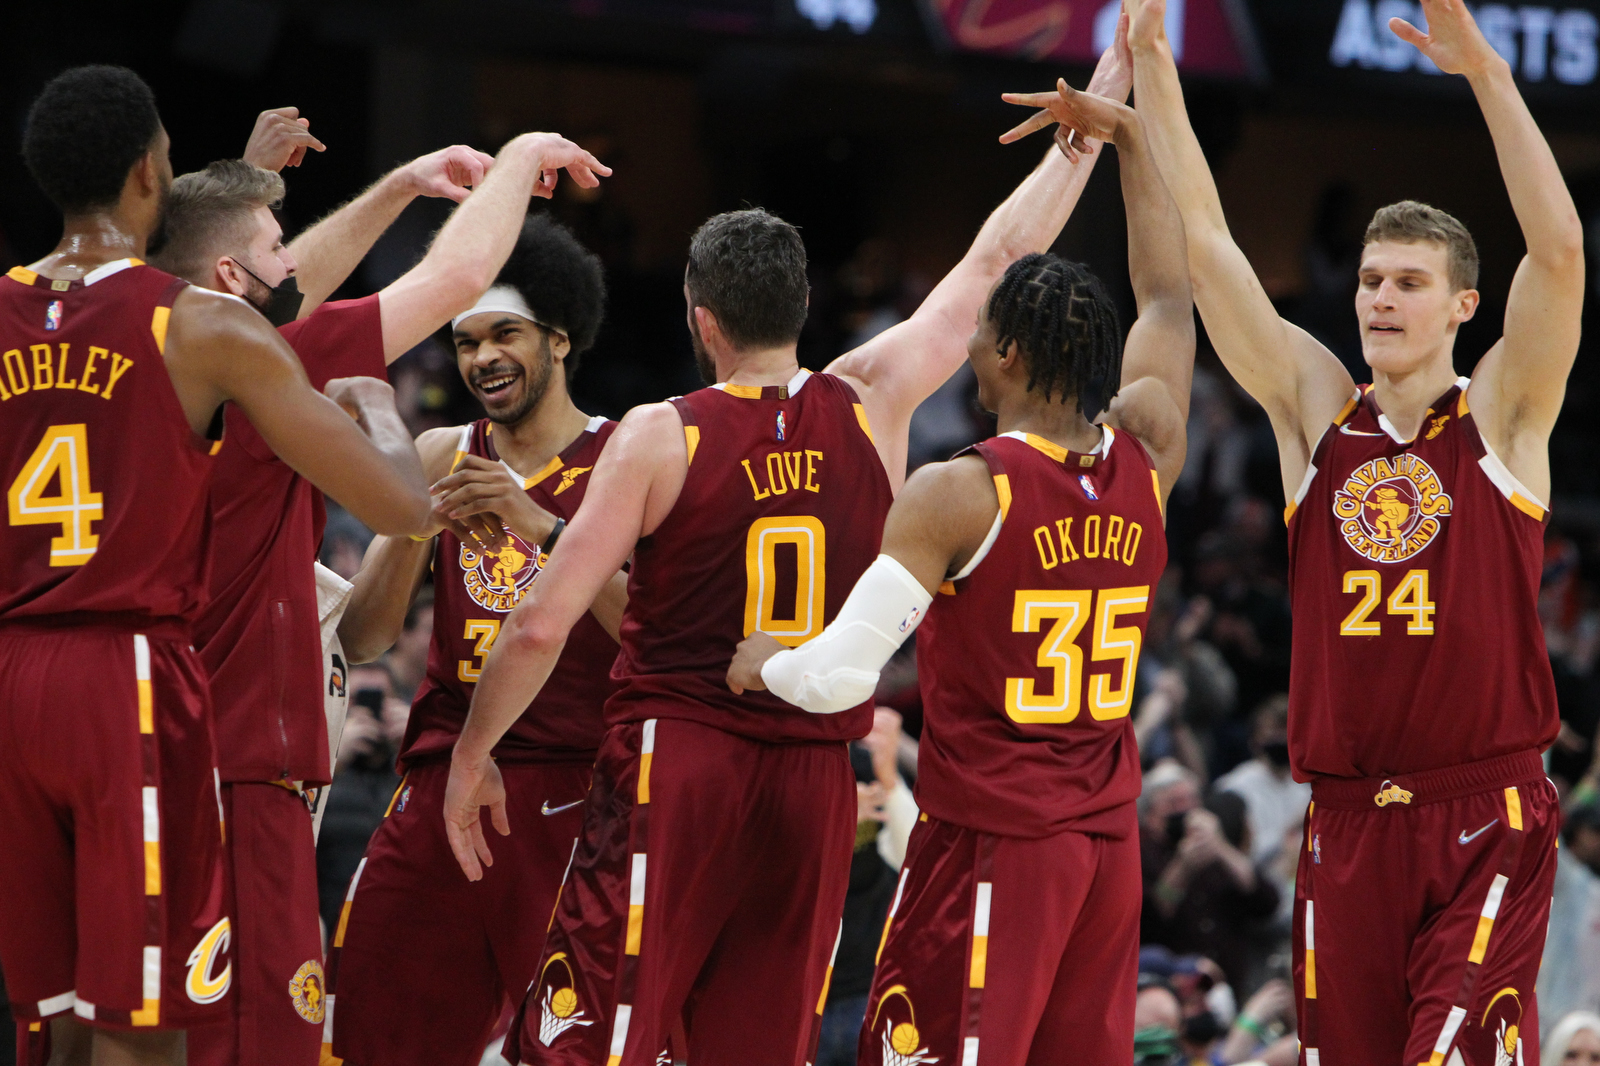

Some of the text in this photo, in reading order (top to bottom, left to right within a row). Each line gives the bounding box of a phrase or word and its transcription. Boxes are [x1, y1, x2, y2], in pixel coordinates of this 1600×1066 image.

[0, 343, 134, 401] OBLEY
[8, 423, 104, 567] 4
[741, 449, 823, 501] LOVE
[1334, 453, 1453, 520] CAVALIERS
[1033, 515, 1142, 570] OKORO
[1341, 516, 1441, 563] CLEVELAND
[1340, 569, 1435, 635] 24
[1005, 585, 1150, 724] 35
